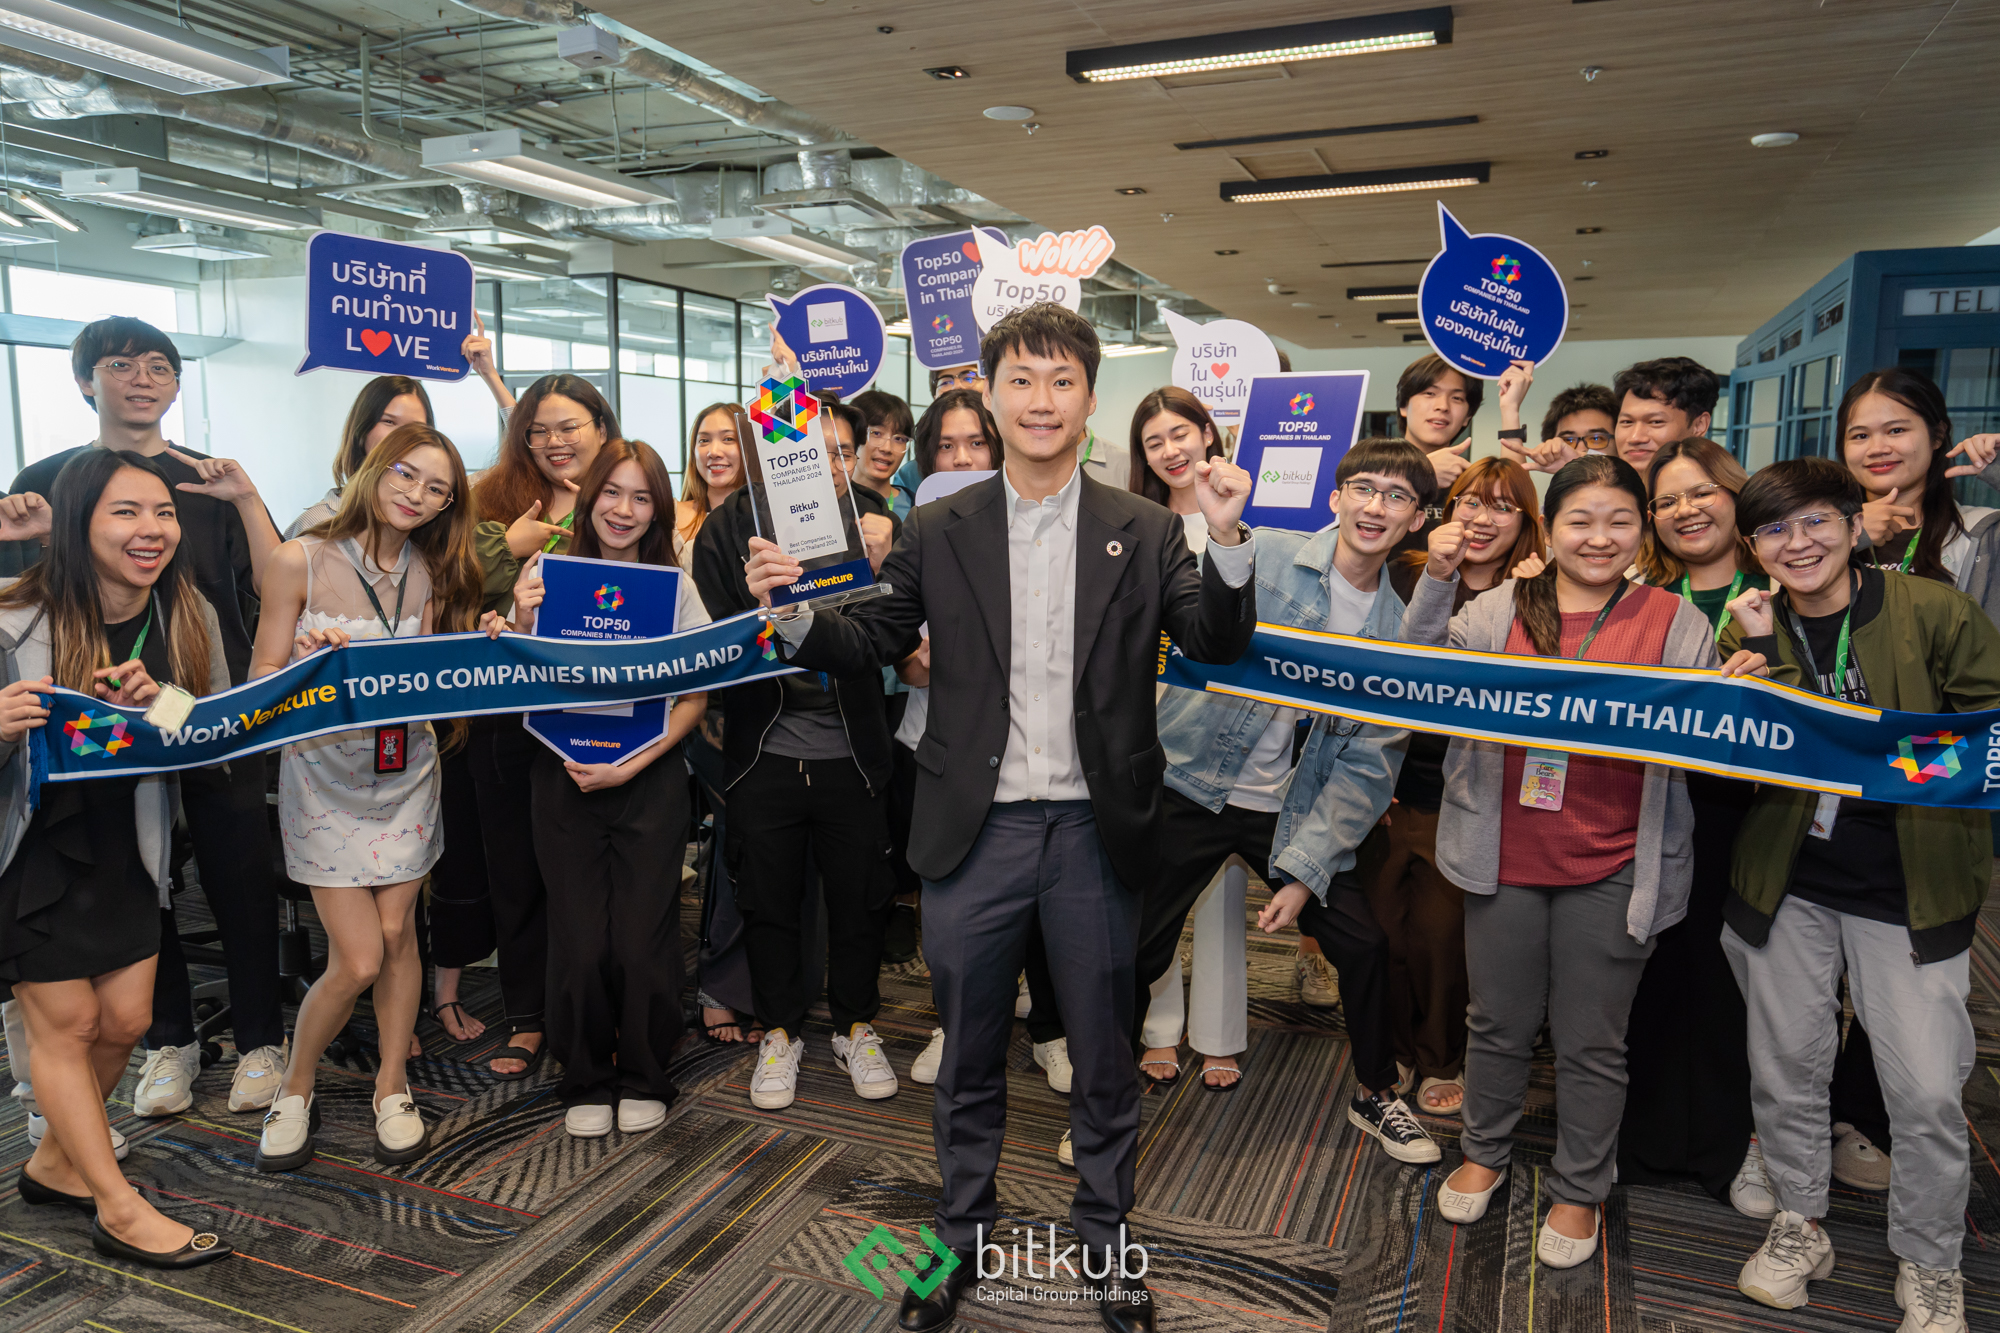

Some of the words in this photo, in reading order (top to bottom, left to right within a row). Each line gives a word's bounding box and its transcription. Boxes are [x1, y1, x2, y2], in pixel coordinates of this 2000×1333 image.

[914, 251, 962, 270] Top50
[332, 260, 427, 295] บริษัทที่
[917, 265, 981, 287] Compani
[920, 291, 935, 304] in
[937, 284, 973, 301] Thail
[993, 278, 1067, 304] Top50
[1463, 284, 1496, 302] COMPANIES
[1495, 297, 1504, 305] IN
[1503, 300, 1531, 315] THAILAND
[1481, 277, 1522, 303] TOP50
[1929, 289, 1994, 314] TEL
[331, 294, 457, 330] คนทำงาน
[1450, 300, 1525, 338] บริษัทในฝัน
[929, 335, 962, 347] TOP50
[1434, 314, 1528, 359] ของคนรุ่นใหม่
[801, 345, 861, 363] บริษัทในฝัน
[1191, 341, 1237, 359] บริษัท
[426, 364, 460, 374] WorkVenture
[1190, 363, 1208, 382] ใน
[1277, 421, 1318, 433] TOP50
[767, 447, 818, 470] TOP50
[771, 465, 811, 480] COMPANIES
[773, 475, 806, 487] THAILAND
[807, 470, 822, 480] 2024
[1282, 470, 1313, 481] bitkub
[790, 500, 819, 514] Bitkub
[799, 513, 815, 523] #36
[789, 572, 854, 595] WorkVenture
[582, 615, 631, 632] TOP50
[561, 628, 604, 639] COMPANIES
[159, 684, 337, 747] WorkVenture
[343, 672, 429, 699] TOP50
[435, 665, 585, 690] COMPANIES
[592, 666, 618, 684] IN
[621, 644, 744, 682] THAILAND
[1264, 656, 1355, 692] TOP50
[1363, 675, 1552, 718] COMPANIES
[1559, 696, 1596, 724] IN
[1604, 700, 1795, 751] THAILAND
[570, 738, 621, 749] WorkVenture
